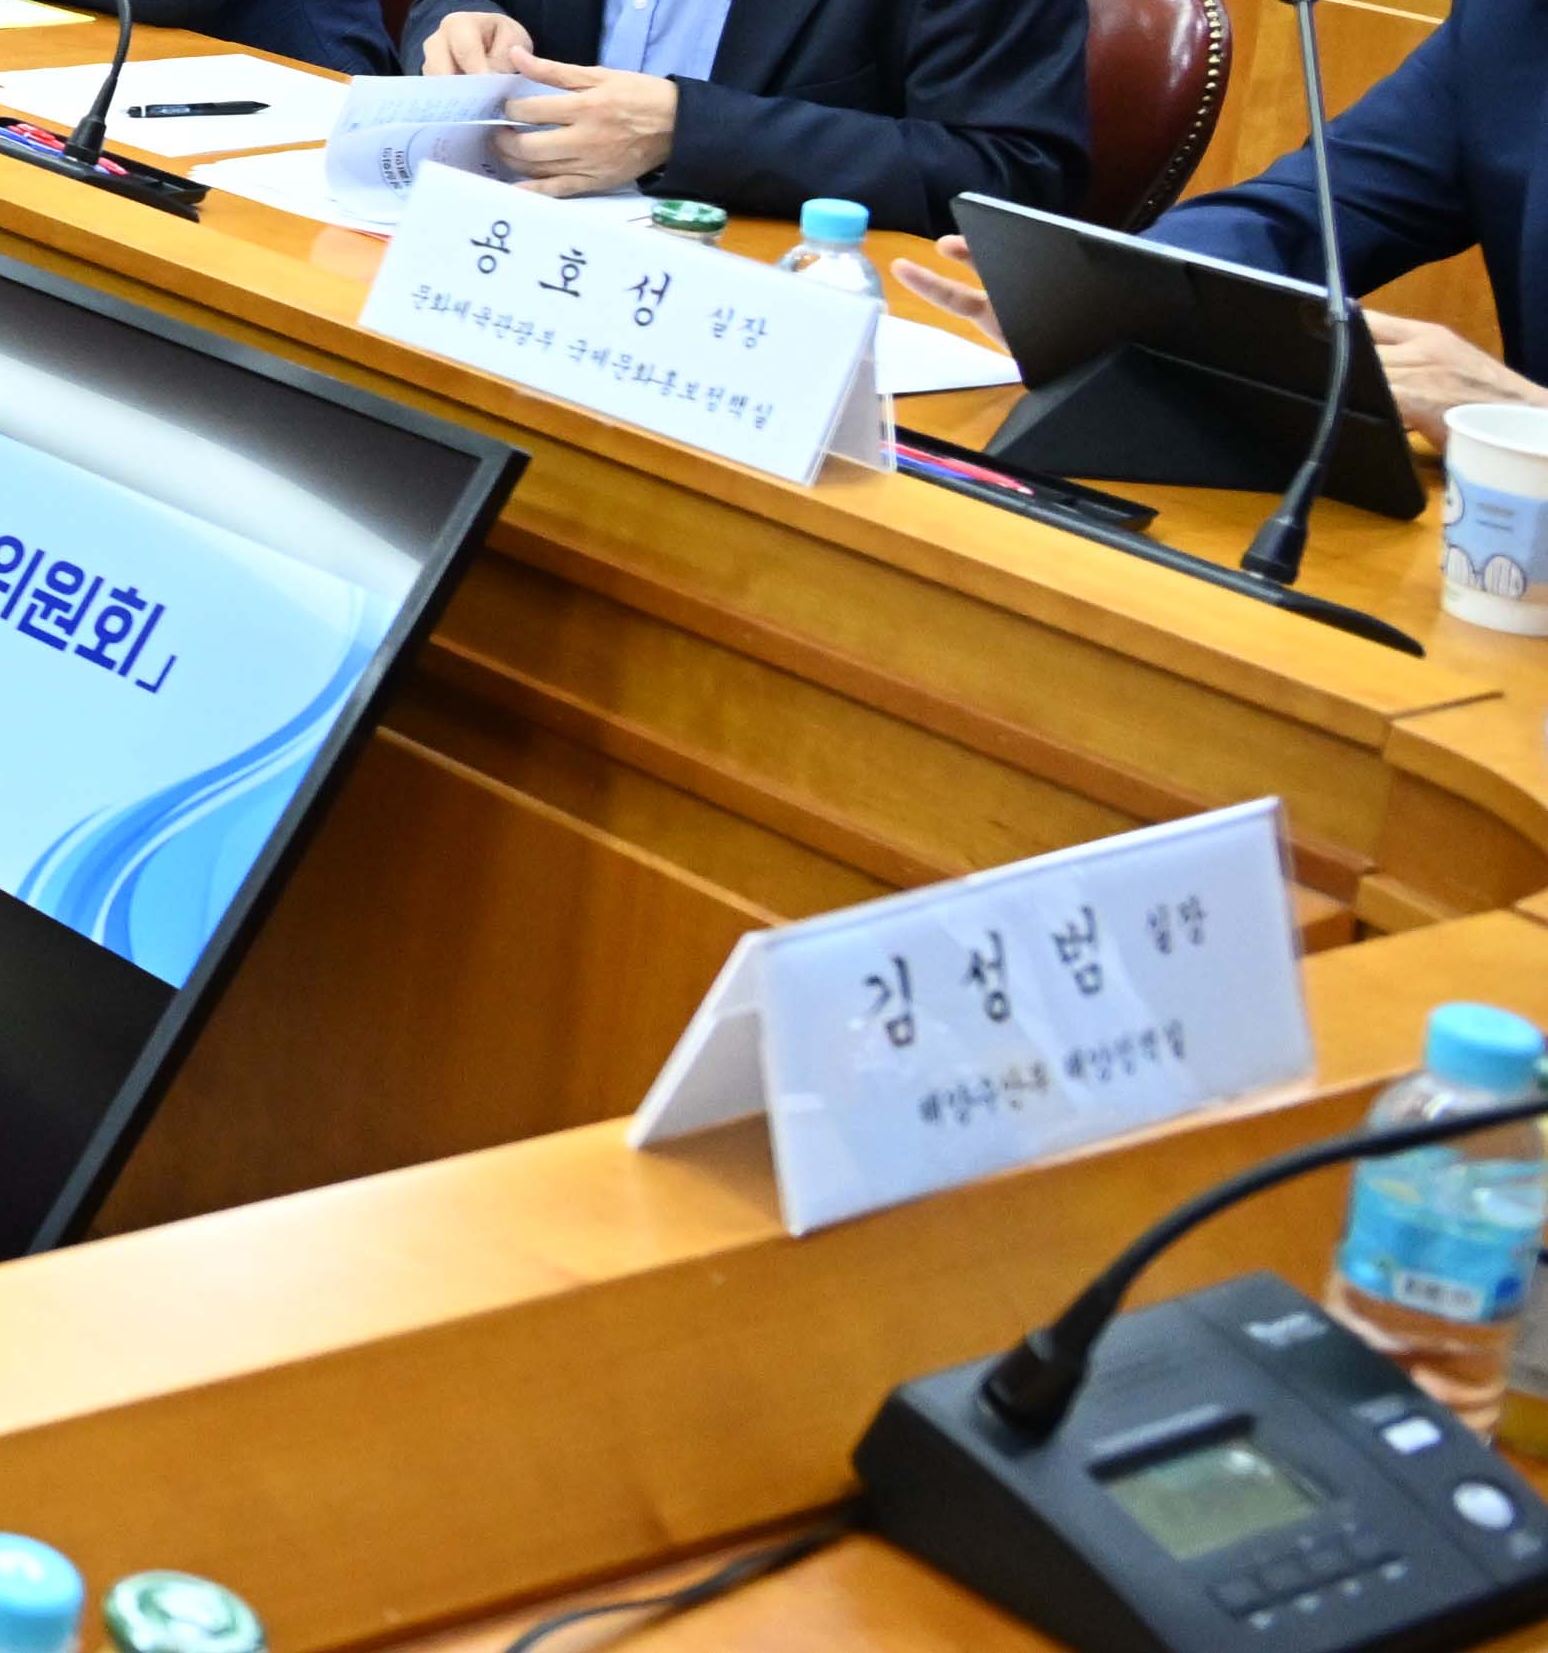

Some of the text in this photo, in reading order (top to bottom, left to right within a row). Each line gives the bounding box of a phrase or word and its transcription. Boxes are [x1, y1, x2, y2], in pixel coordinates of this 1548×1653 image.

[410, 283, 560, 353] 문화체육관광부
[469, 216, 770, 350] 용호성 실장
[862, 895, 1212, 1049] 김성범 실장
[918, 1056, 1052, 1127] 해양수산부
